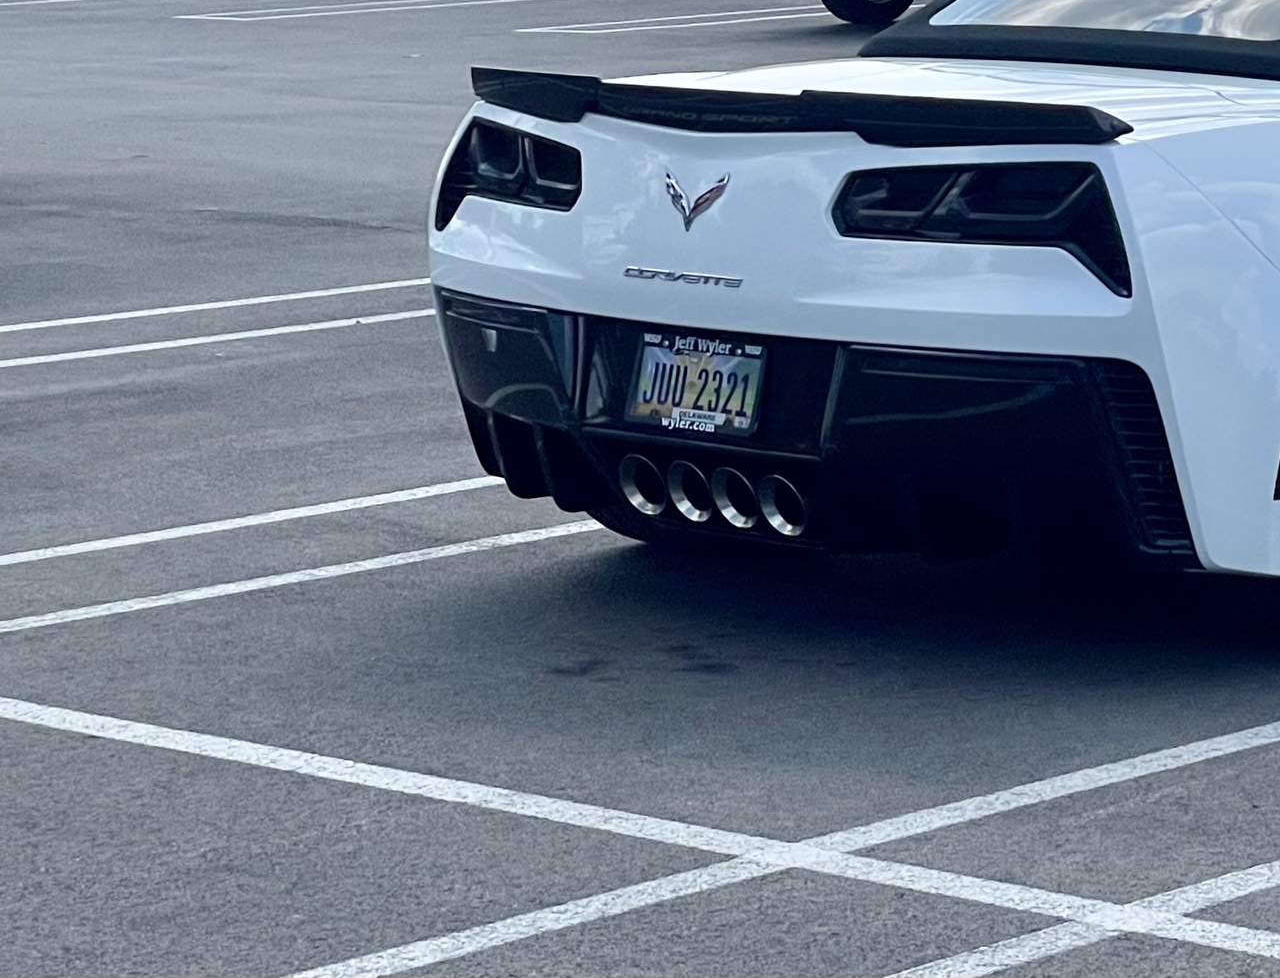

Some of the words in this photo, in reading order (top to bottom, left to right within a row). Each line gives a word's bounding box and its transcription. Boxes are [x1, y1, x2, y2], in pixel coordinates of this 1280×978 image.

[623, 106, 697, 120] GRAND
[700, 113, 797, 125] SPORT
[623, 265, 744, 288] CORVETTE
[673, 335, 697, 353] Jeff
[697, 338, 732, 356] Wyler
[642, 362, 688, 408] JUU
[691, 368, 750, 417] 2321
[661, 416, 715, 433] wyler.com
[679, 410, 717, 422] DELAWARE
